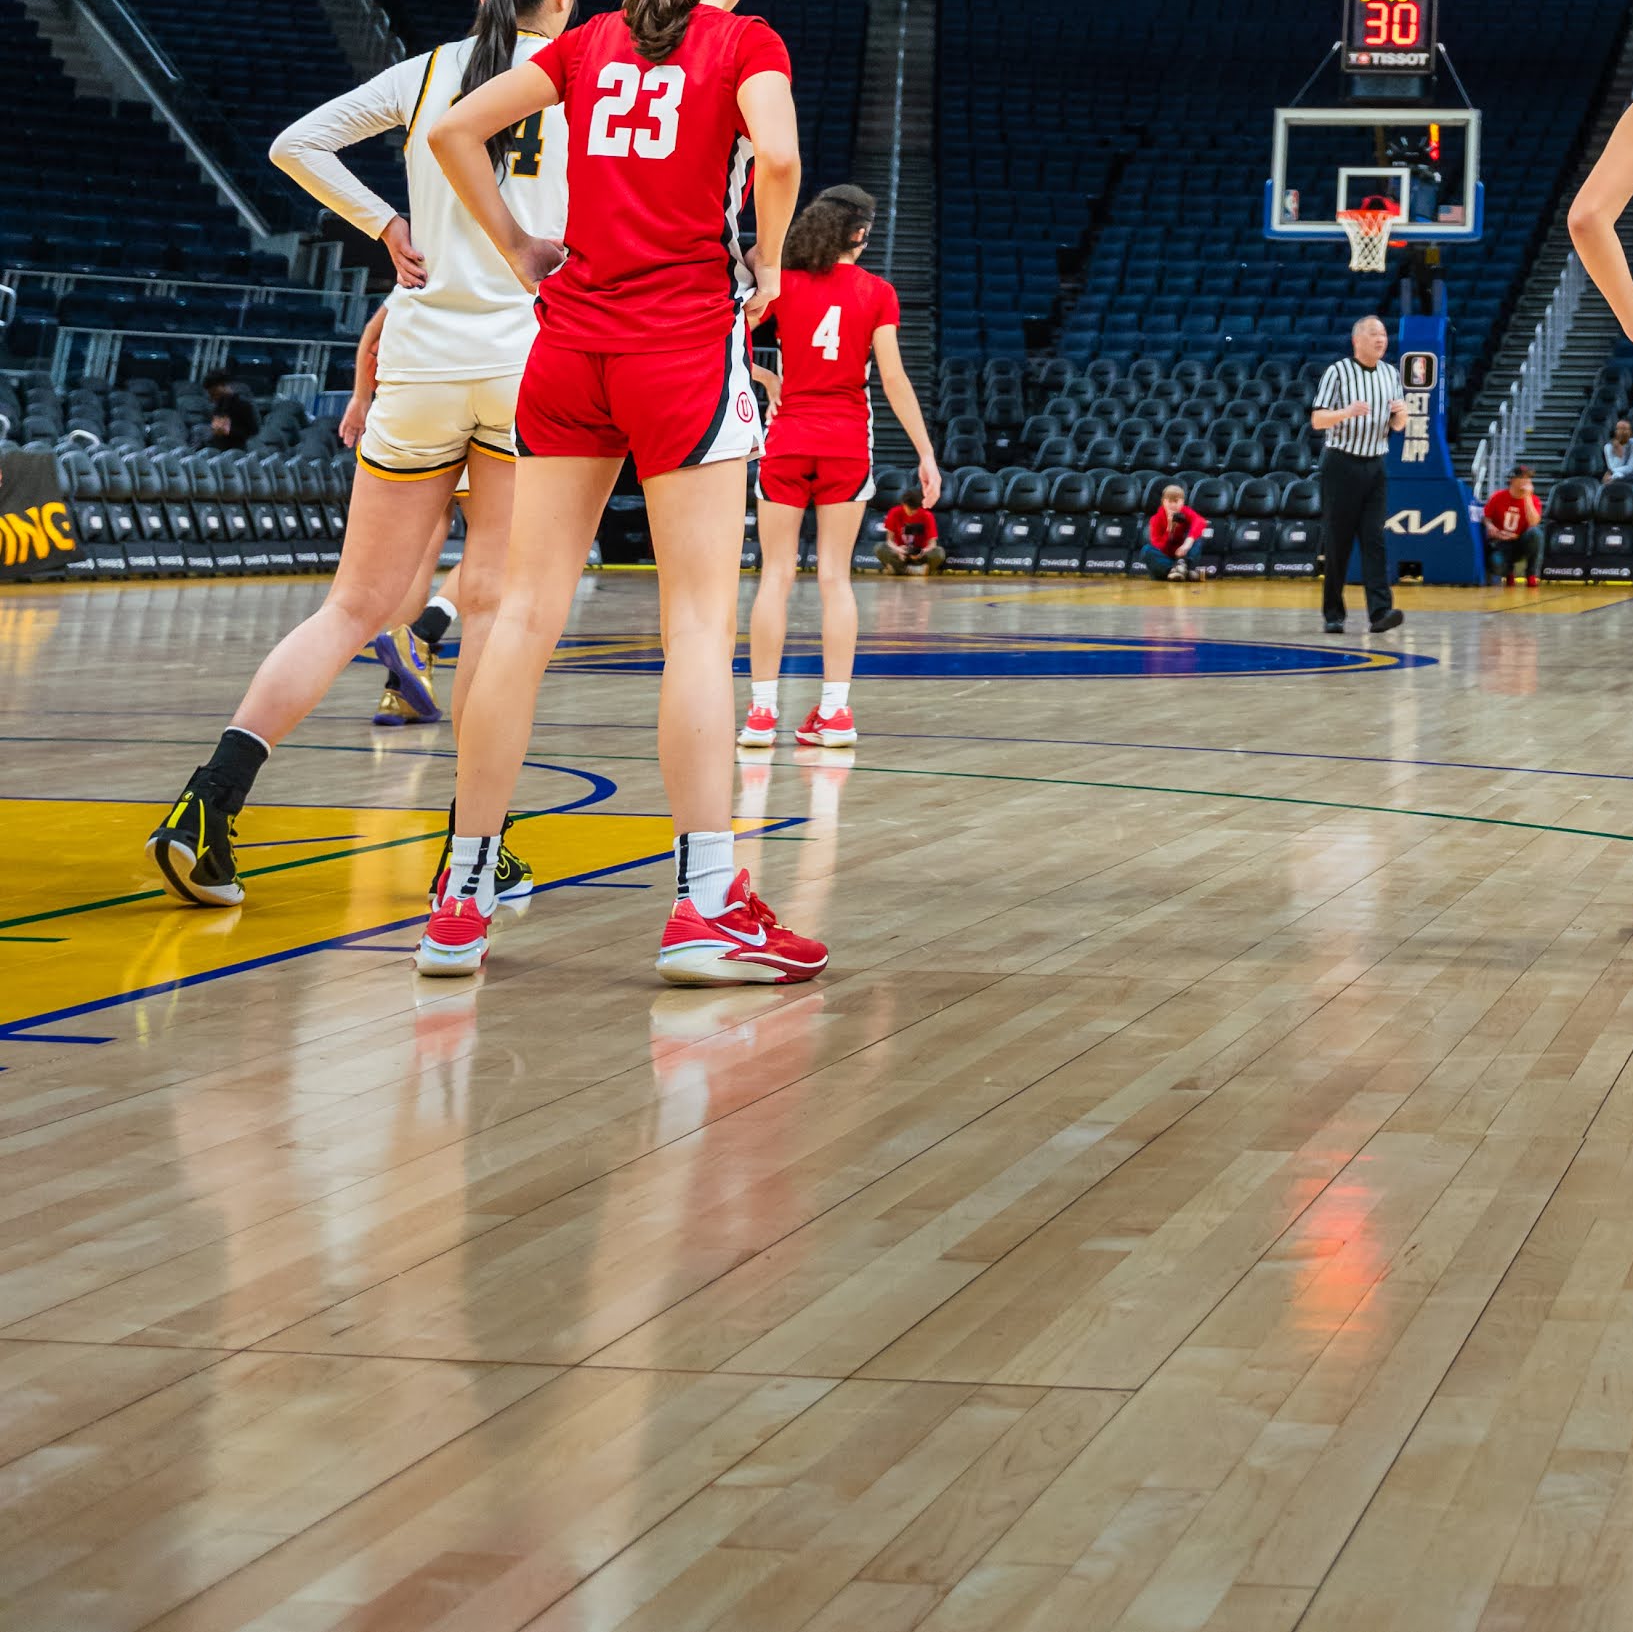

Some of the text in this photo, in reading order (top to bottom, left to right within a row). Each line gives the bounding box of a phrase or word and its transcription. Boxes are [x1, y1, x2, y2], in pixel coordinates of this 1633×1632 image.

[1365, 2, 1419, 47] 30
[1370, 53, 1429, 65] TISSOT
[587, 62, 686, 160] 23
[812, 306, 843, 360] 4
